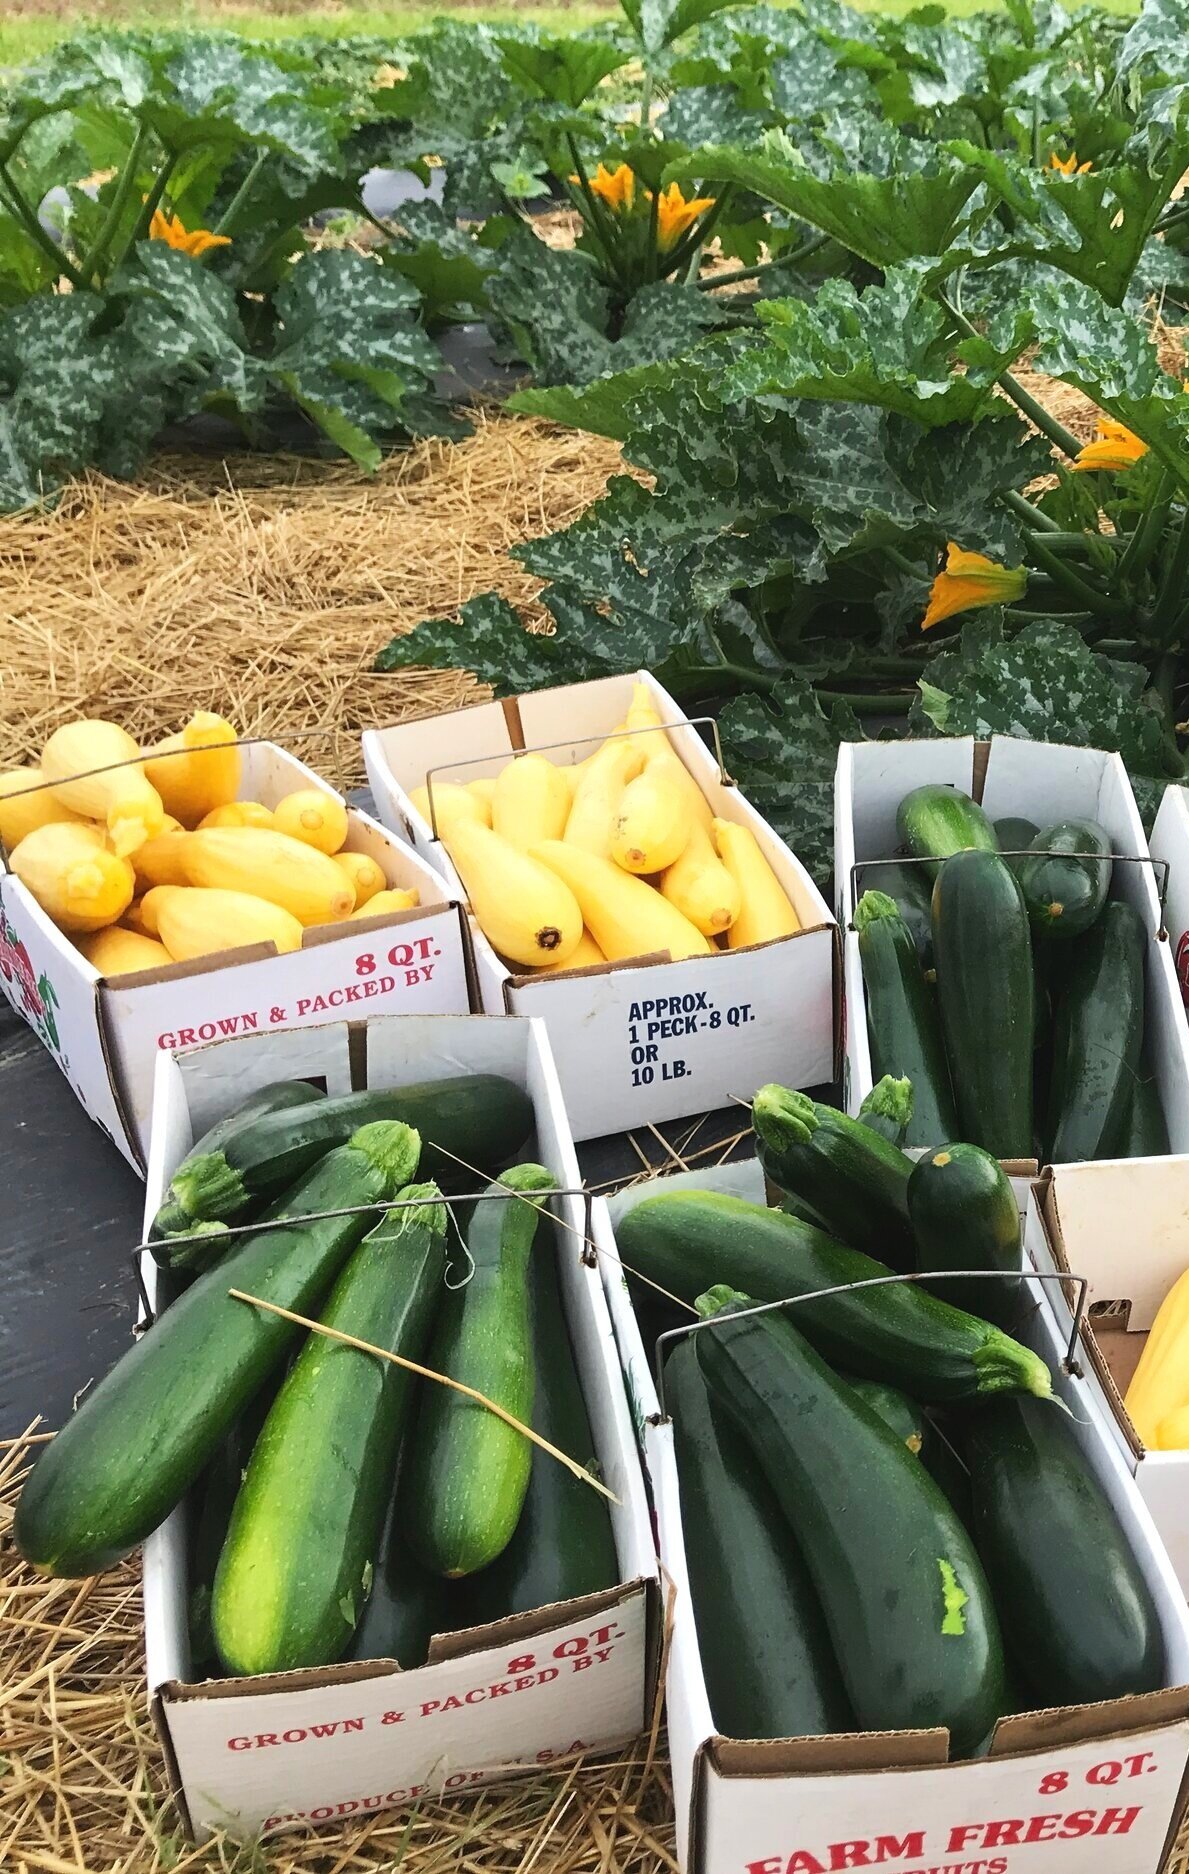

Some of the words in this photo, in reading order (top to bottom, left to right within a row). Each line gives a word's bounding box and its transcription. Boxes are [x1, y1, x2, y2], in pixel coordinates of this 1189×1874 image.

[355, 953, 376, 976] 8
[388, 936, 442, 968] QT.
[158, 1012, 258, 1050] GROWN
[269, 1006, 287, 1024] &
[297, 976, 396, 1016] PACKED
[405, 964, 435, 987] BY
[628, 991, 714, 1022] APPROX.
[628, 1025, 640, 1044] 1
[727, 1004, 756, 1027] QT.
[631, 1044, 659, 1065] OR
[631, 1066, 655, 1087] 10
[662, 1059, 692, 1081] LB.
[507, 1653, 537, 1675] 8
[552, 1622, 626, 1660] QT.
[227, 1717, 365, 1752] GROWN
[381, 1711, 404, 1726] &
[420, 1666, 559, 1718] PACKED
[573, 1645, 615, 1672] BY
[1038, 1771, 1069, 1795] 8
[1085, 1752, 1159, 1785] QT.
[744, 1831, 927, 1874] FARM
[945, 1805, 1144, 1853] FRESH
